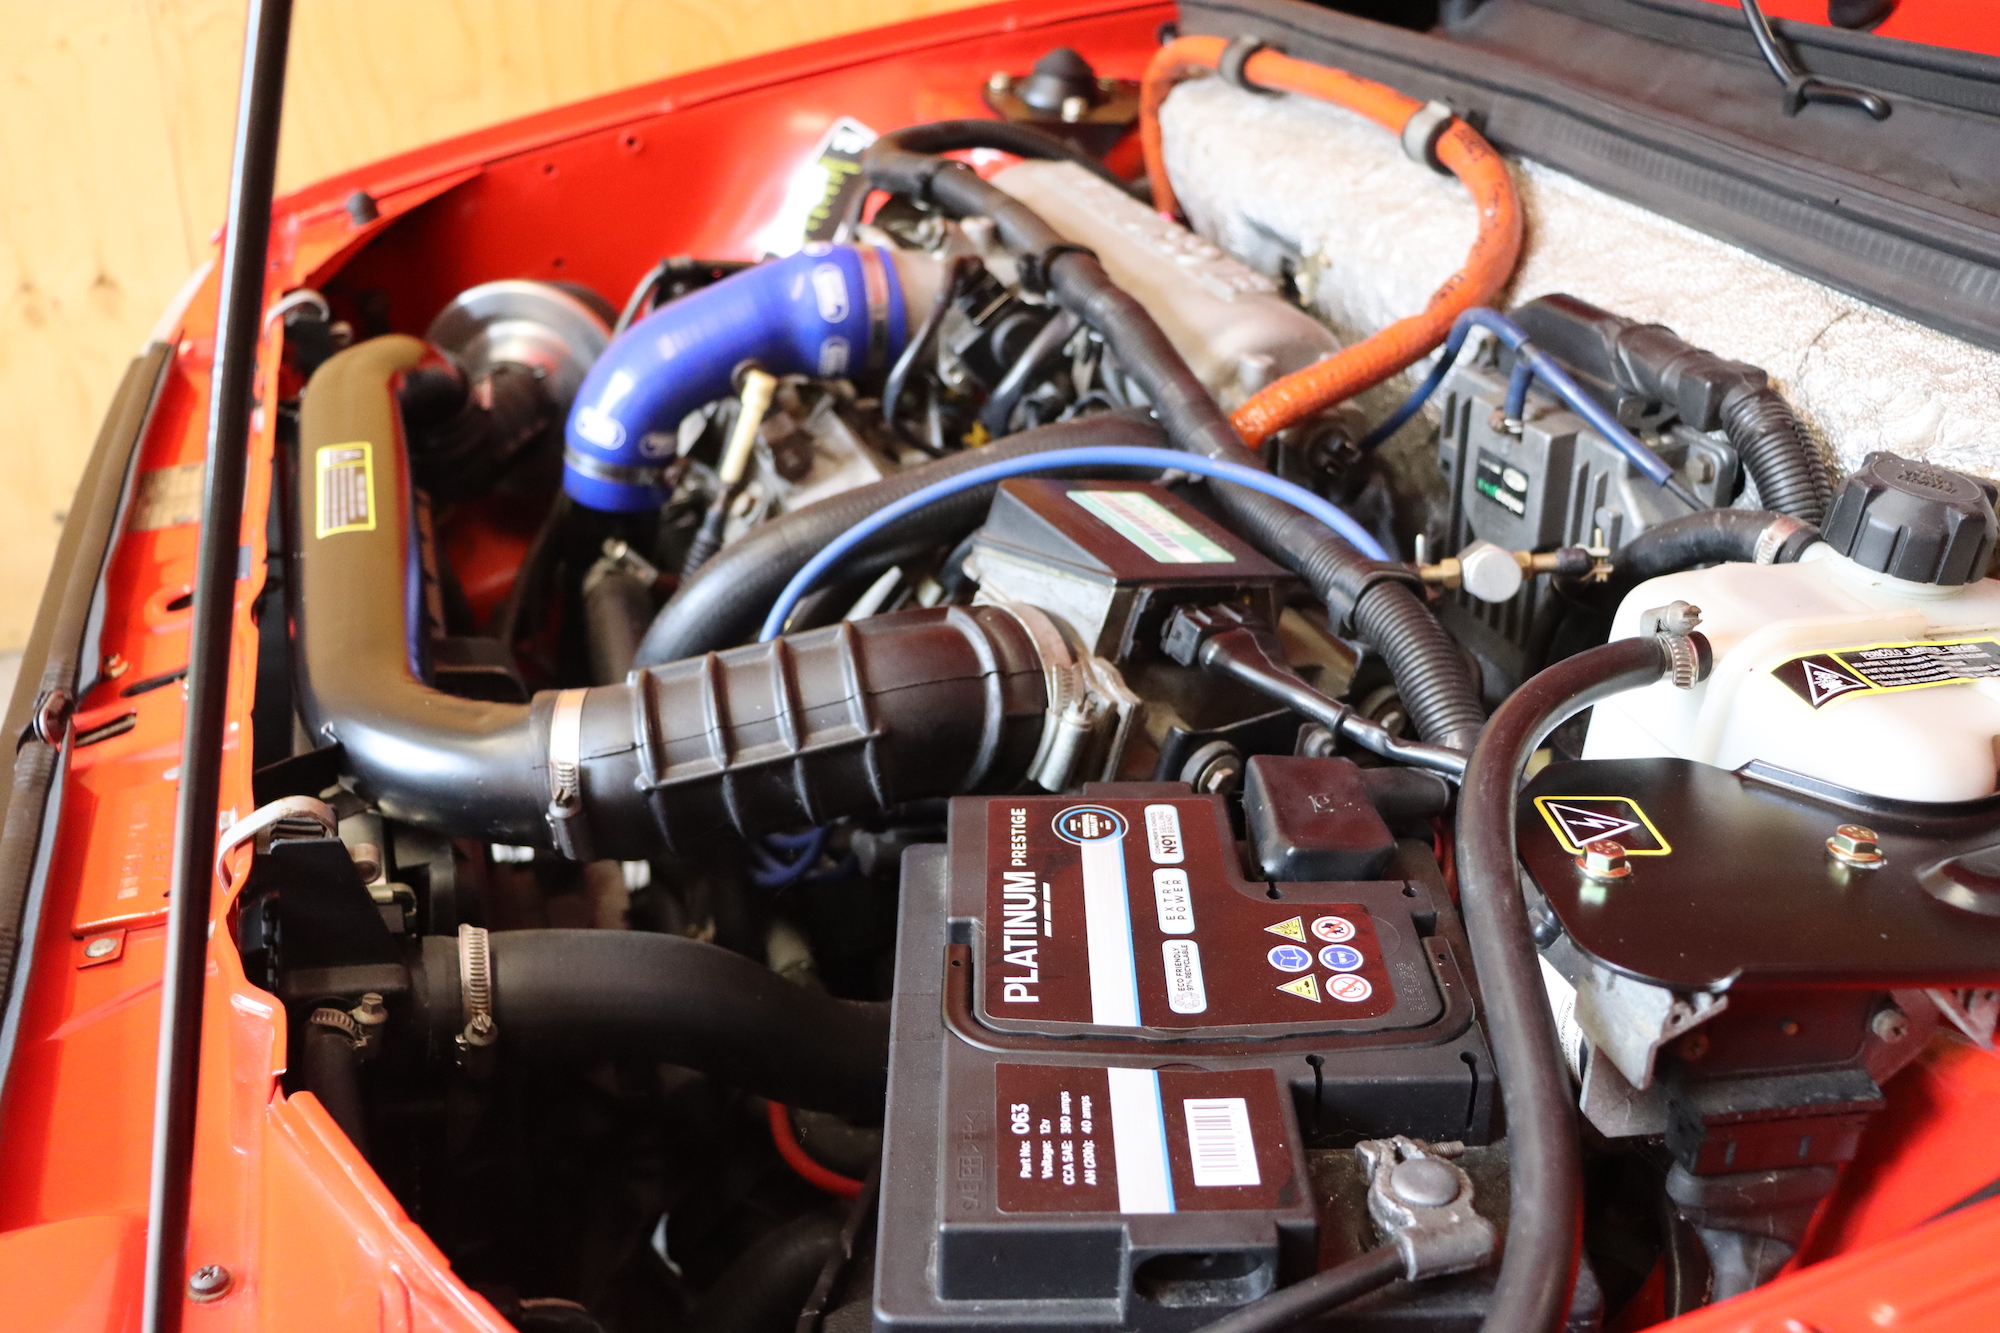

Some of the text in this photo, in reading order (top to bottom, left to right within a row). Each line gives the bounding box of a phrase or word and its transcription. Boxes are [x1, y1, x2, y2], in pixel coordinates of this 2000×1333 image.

[1165, 814, 1175, 833] BRAND
[1003, 808, 1039, 1003] PLATINUM PRESTIGE
[1161, 879, 1176, 920] EXTRA
[1172, 879, 1187, 920] POWER
[1172, 946, 1185, 992] ECO FRIENDLY
[1181, 944, 1192, 979] RECYCLABLE
[1081, 1095, 1092, 1120] amps
[1081, 1120, 1093, 1135] 40
[1011, 1103, 1032, 1179] Part No: 063
[1040, 1118, 1055, 1180] Voltage: 12v
[1060, 1091, 1076, 1186] CCA SAE: 380 amps
[1084, 1169, 1098, 1186] AH
